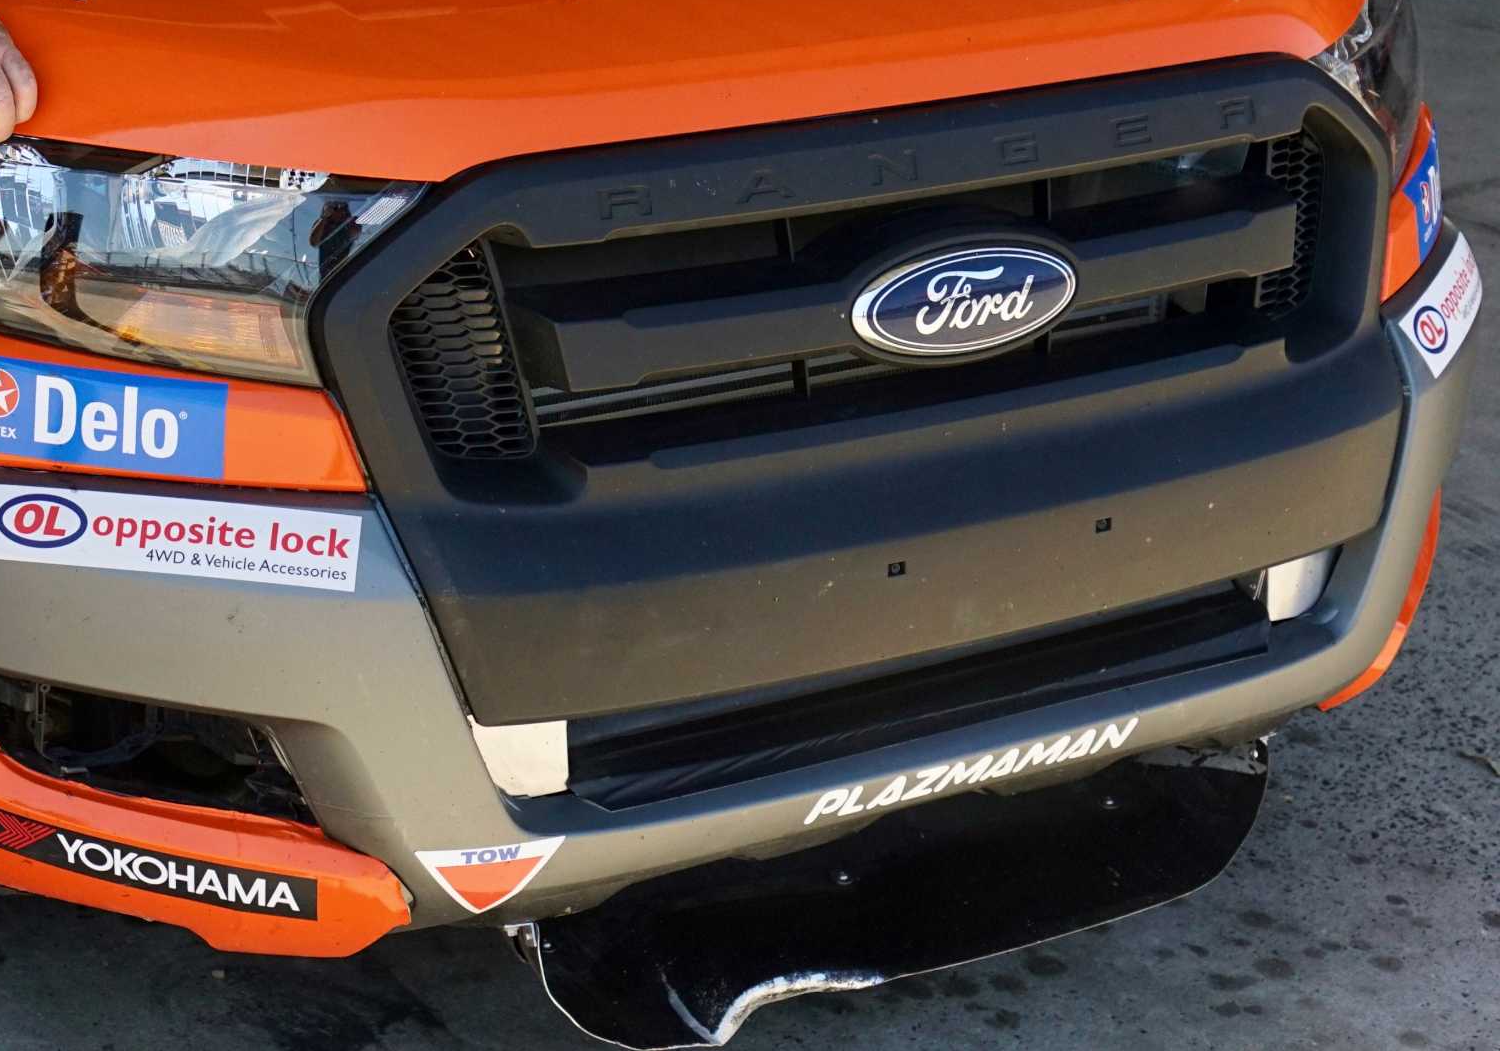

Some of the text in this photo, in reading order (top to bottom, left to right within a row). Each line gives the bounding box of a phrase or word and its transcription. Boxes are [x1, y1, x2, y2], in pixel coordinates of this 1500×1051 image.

[600, 95, 1257, 219] RANGER
[915, 264, 1034, 336] Ford
[33, 374, 180, 459] Delo
[13, 503, 350, 559] OL opposite lock
[145, 548, 348, 582] 4WD & Vehicle Accessories
[804, 717, 1140, 825] PLAZMAMAN
[57, 833, 301, 912] YOKOHAMA
[461, 844, 522, 866] TOW
